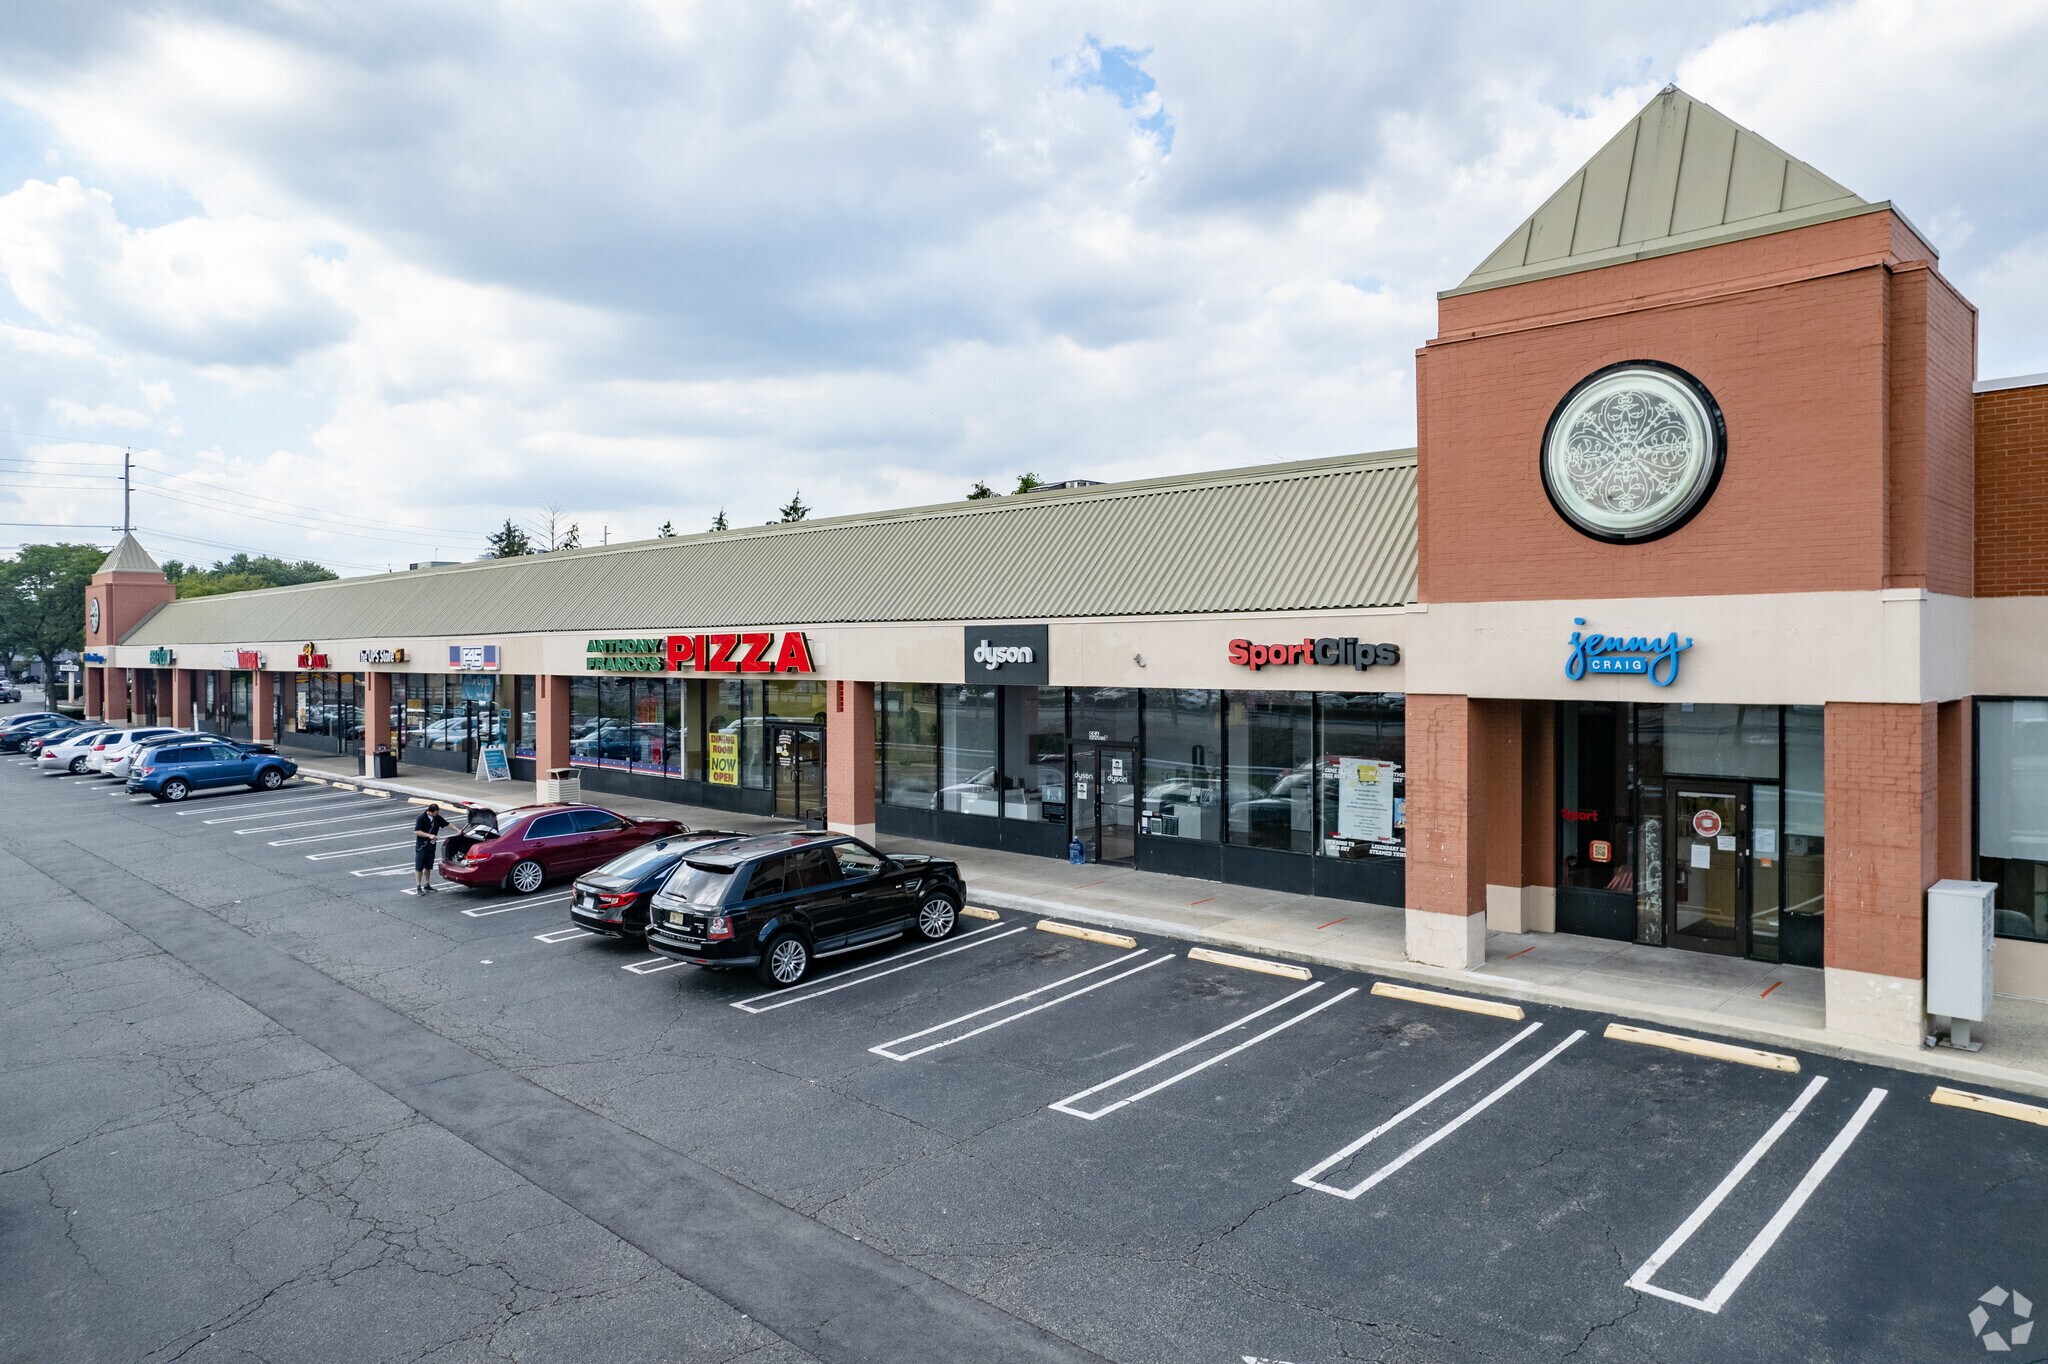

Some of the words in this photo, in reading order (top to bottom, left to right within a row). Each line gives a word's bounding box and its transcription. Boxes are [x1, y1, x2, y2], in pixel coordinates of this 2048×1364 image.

[586, 638, 661, 653] ANTHONY
[667, 632, 814, 673] PIZZA
[1565, 617, 1693, 687] jenny
[973, 639, 1034, 670] dyson
[586, 656, 662, 672] FRANCO'S
[1592, 660, 1642, 670] CRAIG
[711, 735, 735, 745] DINING
[712, 745, 734, 754] ROOM
[711, 757, 737, 772] NOW
[713, 772, 734, 783] OPEN
[1074, 770, 1094, 781] dyson
[1107, 773, 1128, 785] dyson
[1561, 807, 1598, 821] Sport
